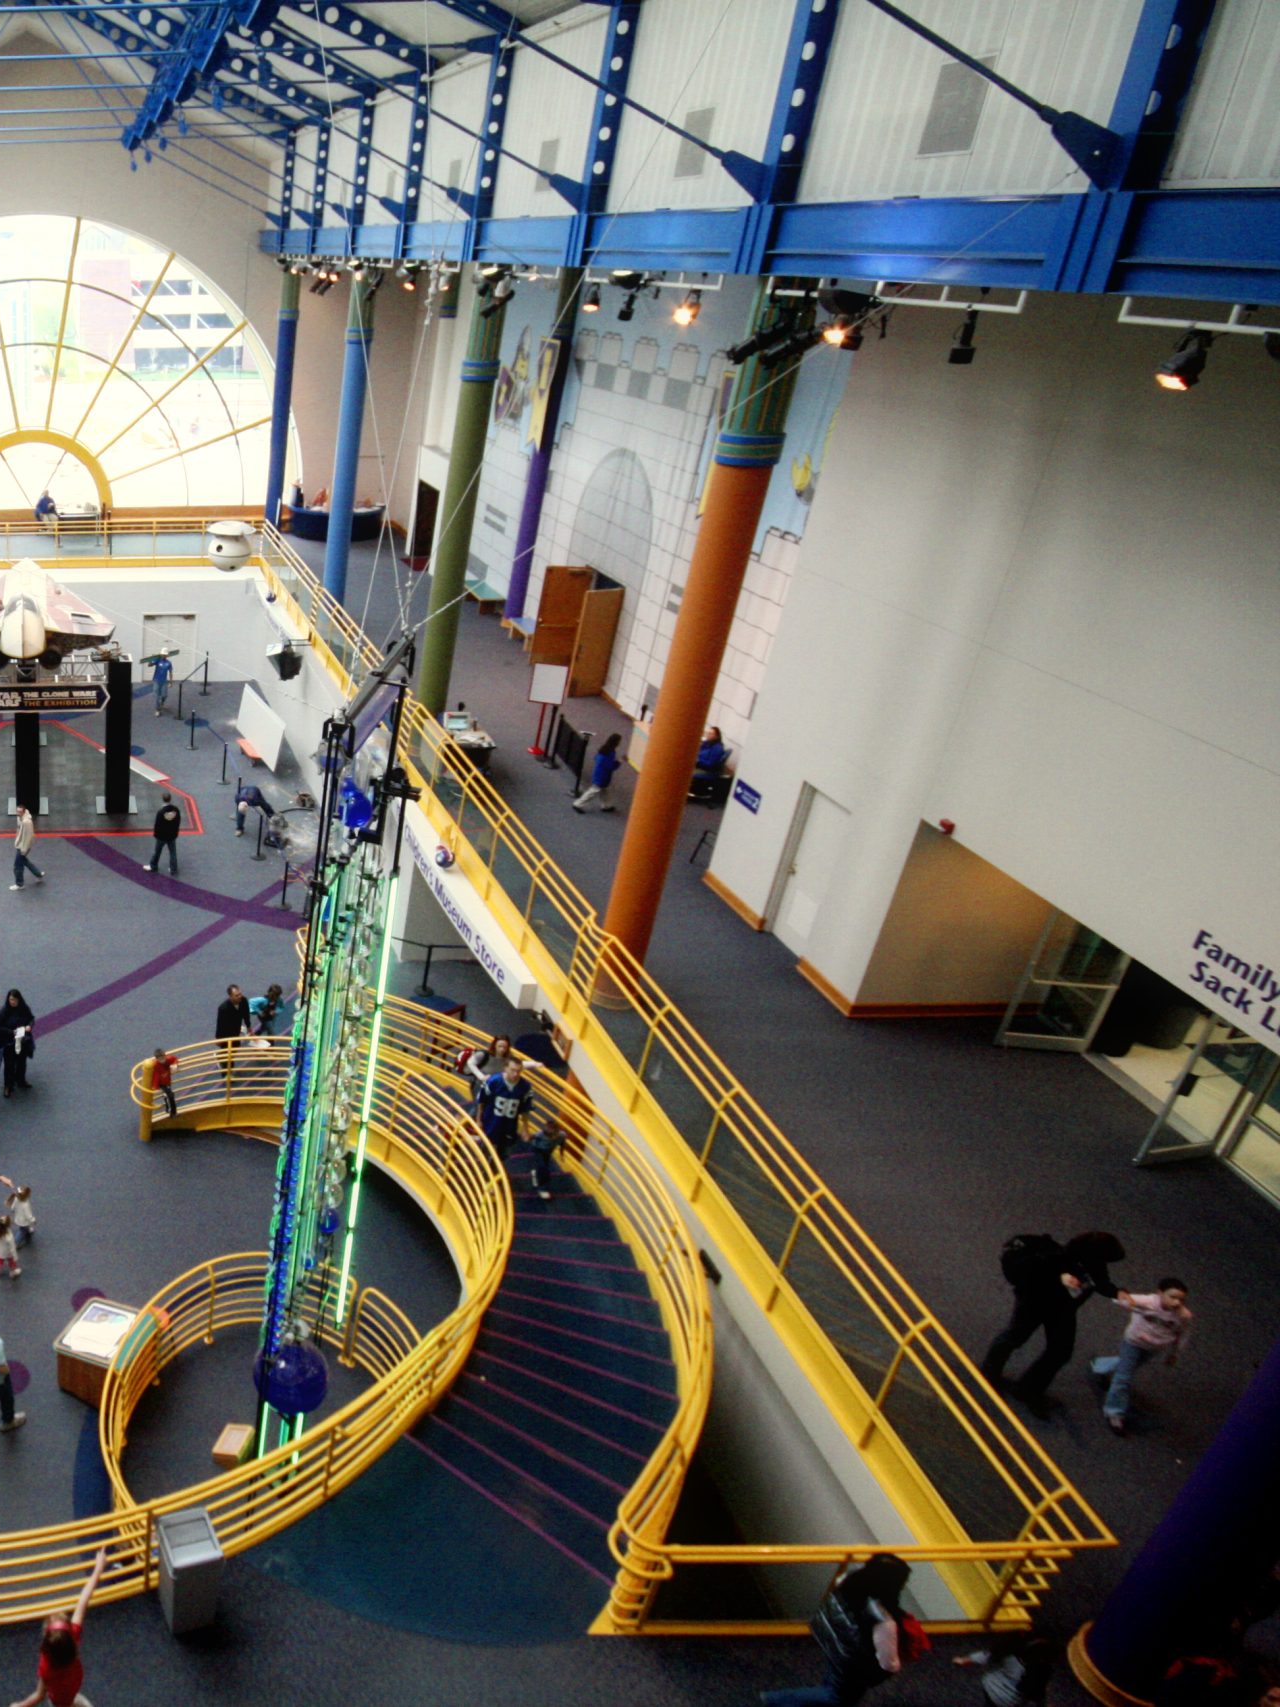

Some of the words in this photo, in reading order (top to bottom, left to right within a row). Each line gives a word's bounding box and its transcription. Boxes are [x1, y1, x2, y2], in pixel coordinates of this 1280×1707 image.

[44, 699, 97, 707] EXHIBITION
[72, 690, 97, 698] WARS
[434, 877, 473, 941] Museum
[474, 934, 506, 985] Store
[1192, 928, 1280, 1003] Family
[1188, 961, 1254, 1015] Sack
[493, 1095, 520, 1119] 98
